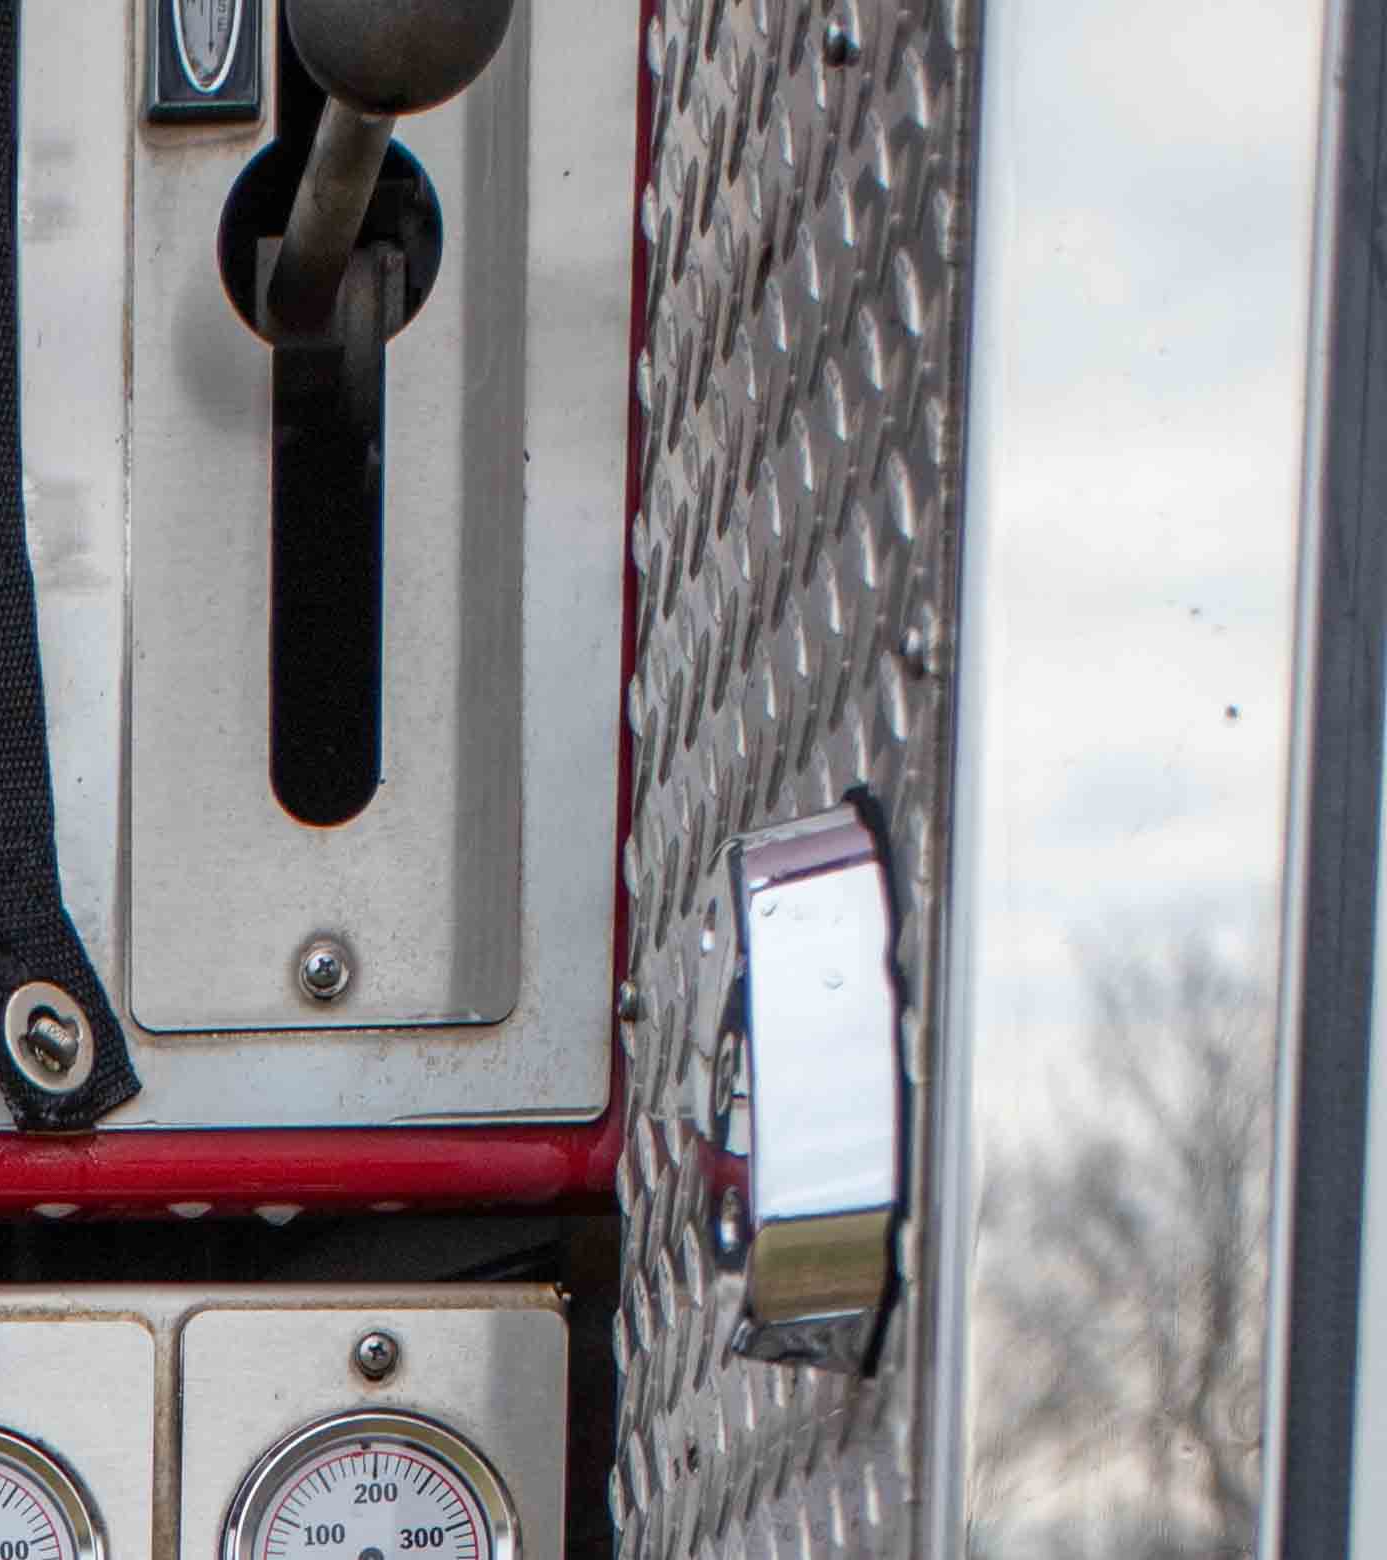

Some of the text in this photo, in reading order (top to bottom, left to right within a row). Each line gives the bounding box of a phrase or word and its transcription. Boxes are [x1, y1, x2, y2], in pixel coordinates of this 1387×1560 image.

[354, 1483, 397, 1504] 200
[304, 1524, 345, 1546] 100
[400, 1527, 444, 1549] 300
